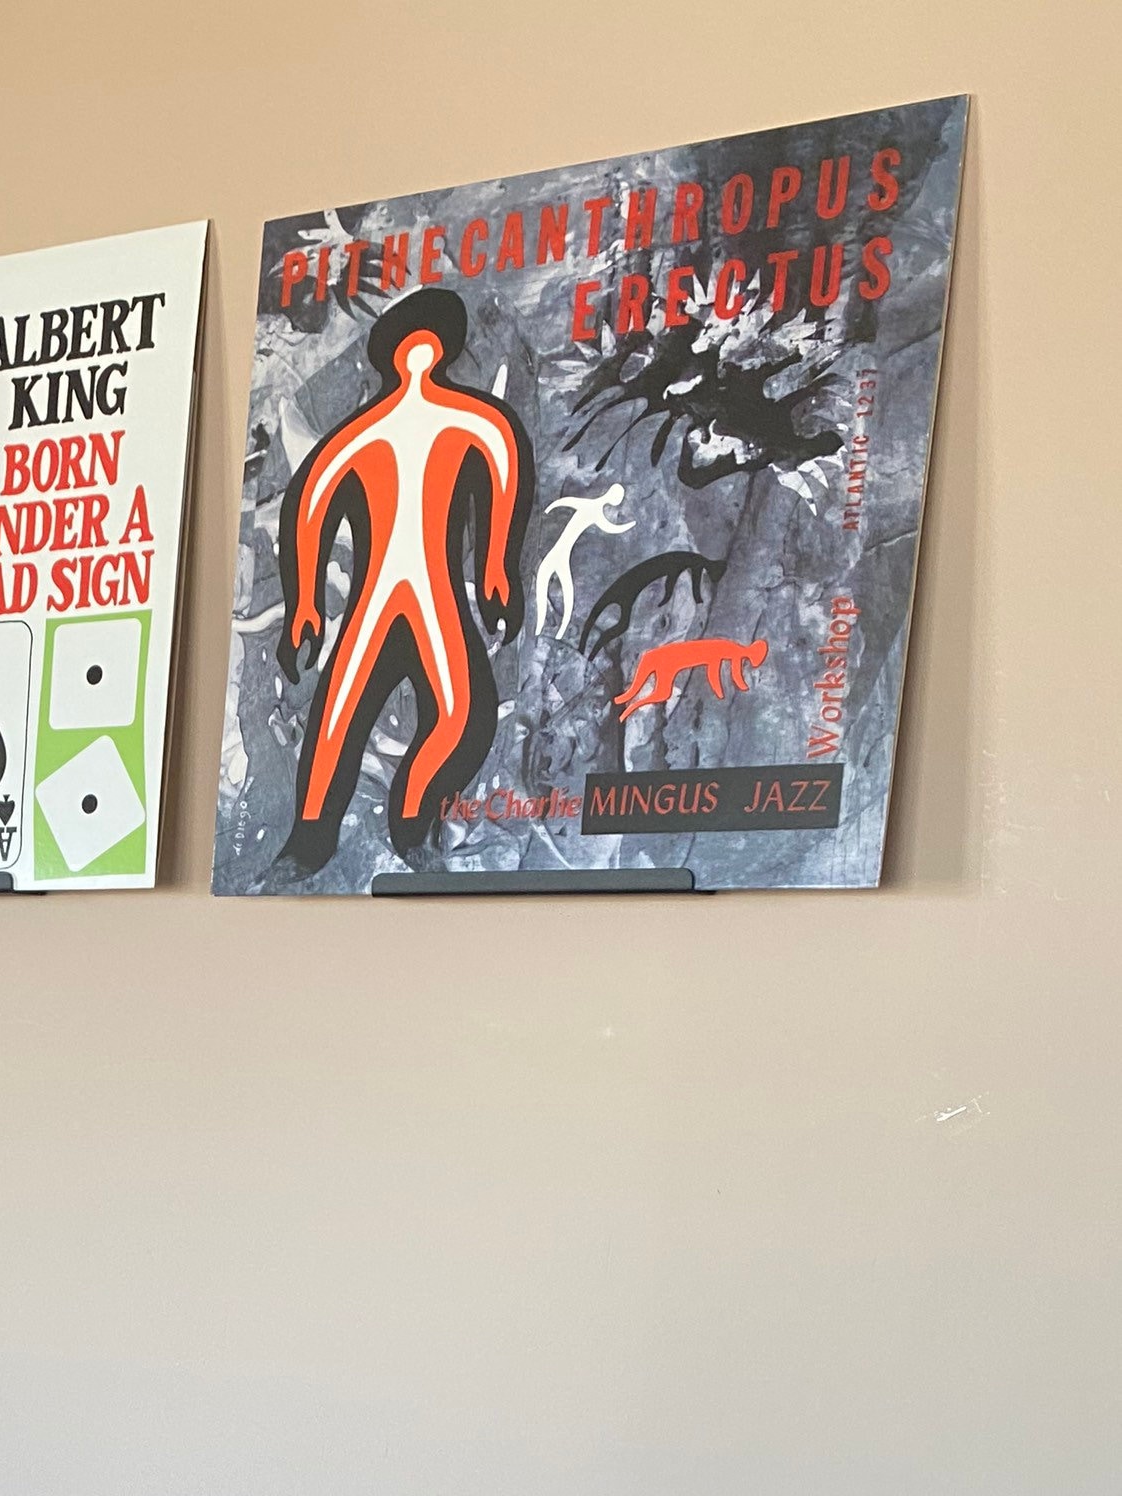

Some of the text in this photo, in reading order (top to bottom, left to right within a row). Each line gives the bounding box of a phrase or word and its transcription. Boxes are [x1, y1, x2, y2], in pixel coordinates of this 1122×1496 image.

[280, 147, 902, 308] PITHECANTHROPUS
[571, 237, 893, 343] ERECTUS
[8, 361, 128, 430] KING
[0, 430, 125, 496] BORN
[842, 435, 870, 532] ATLANTIC
[119, 484, 154, 545] A
[46, 550, 155, 612] SIGN
[807, 596, 862, 760] Workshop
[439, 779, 832, 822] the Charlie MINGUS JAZZ
